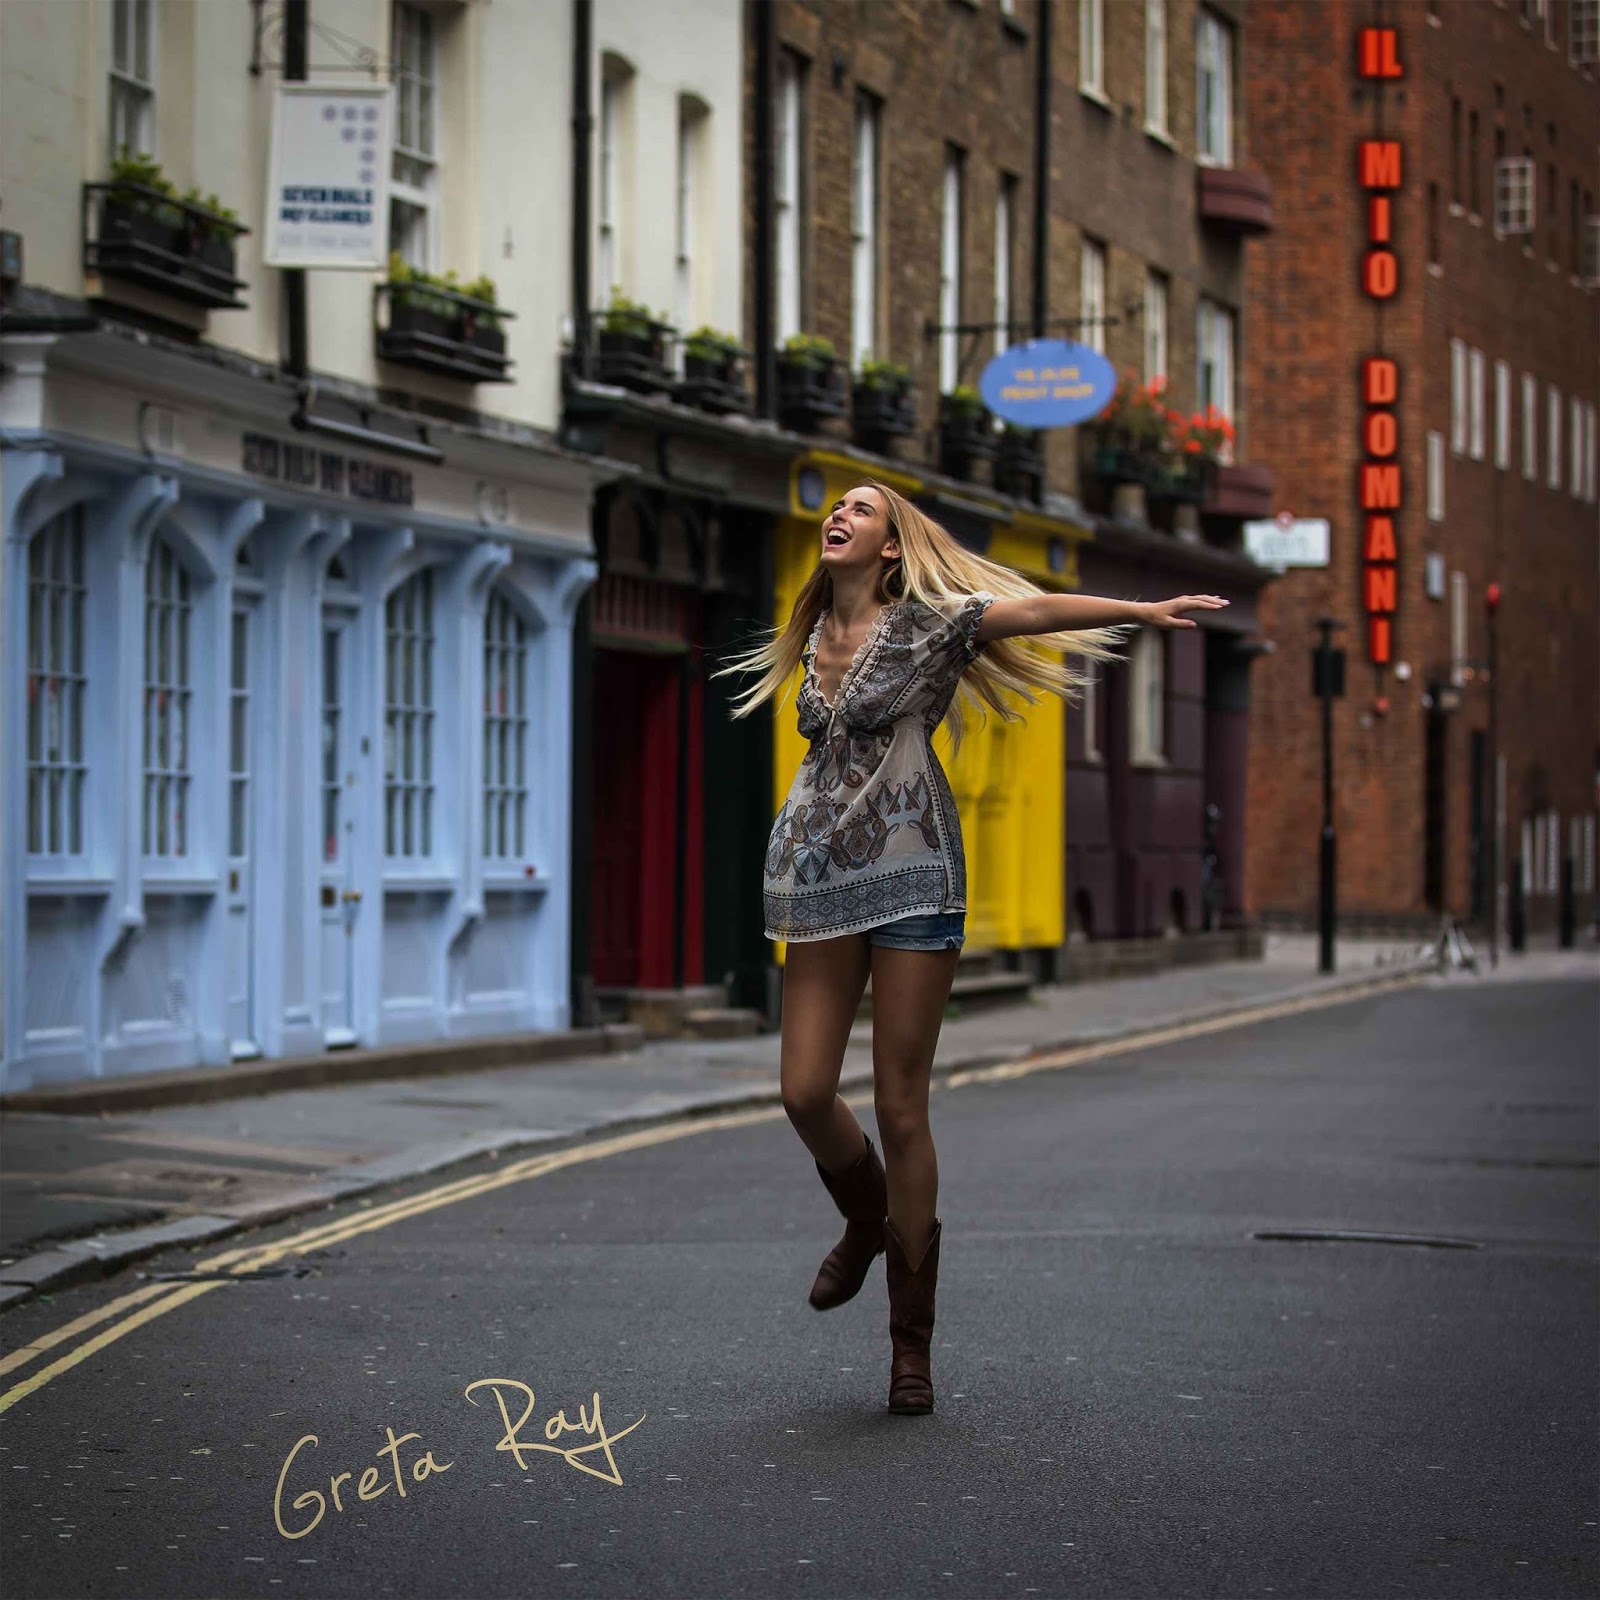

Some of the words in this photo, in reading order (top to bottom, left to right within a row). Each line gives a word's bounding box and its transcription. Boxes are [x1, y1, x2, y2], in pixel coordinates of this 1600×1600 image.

[1360, 29, 1403, 77] IL
[1360, 141, 1401, 297] MIO
[1360, 358, 1401, 663] DOMANI
